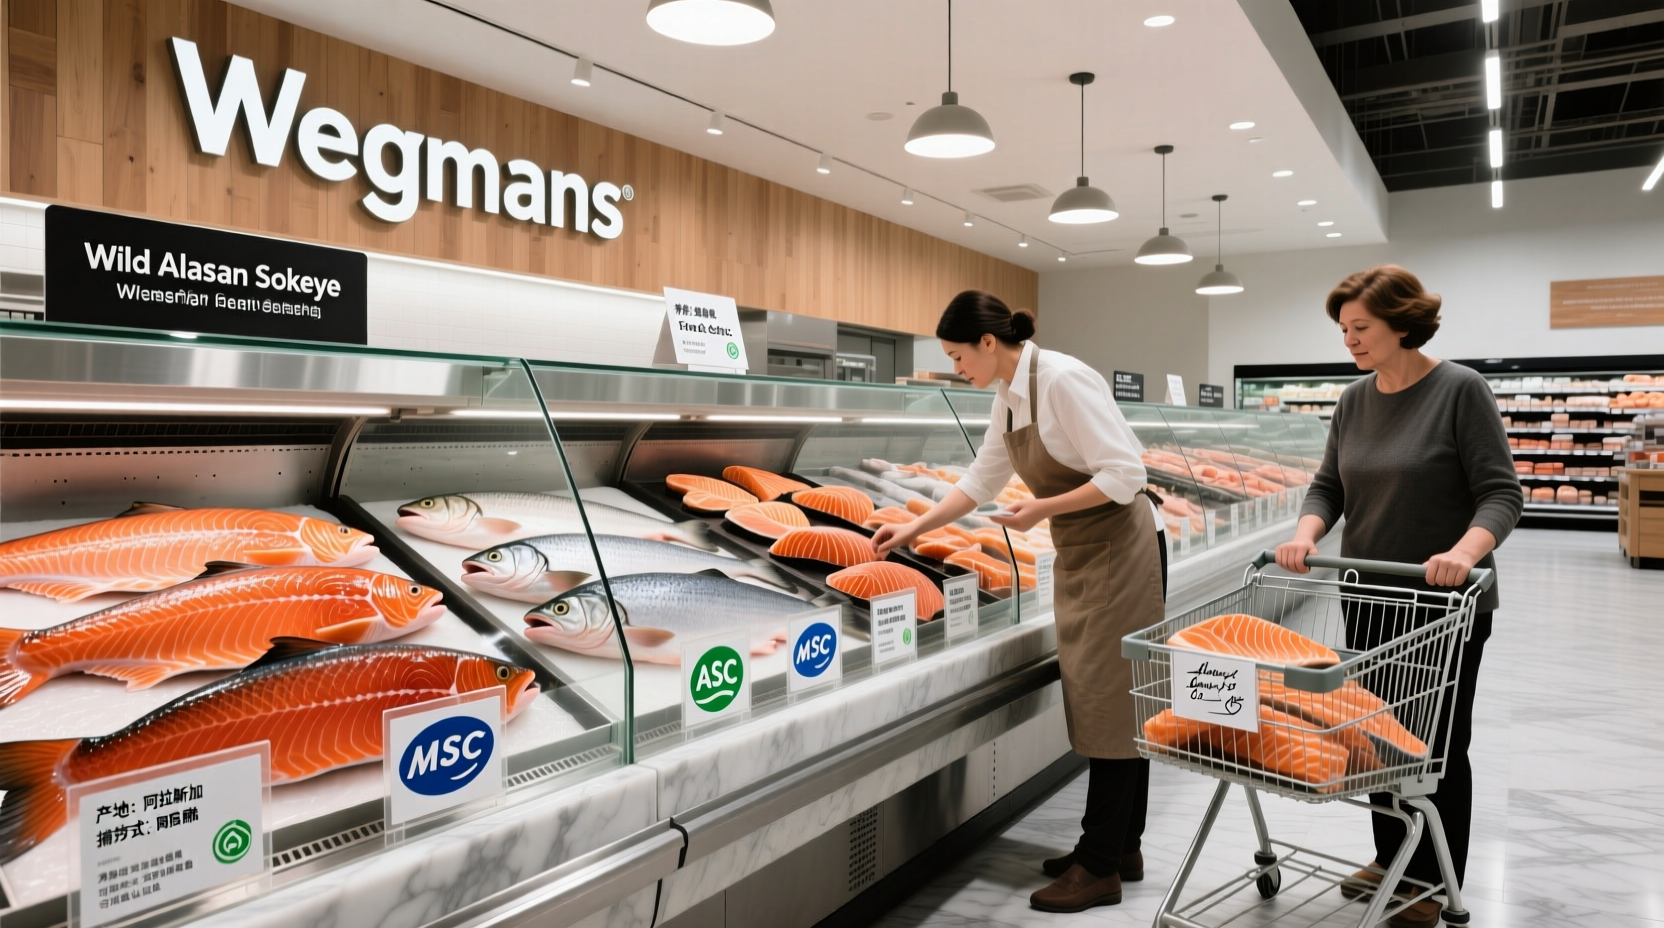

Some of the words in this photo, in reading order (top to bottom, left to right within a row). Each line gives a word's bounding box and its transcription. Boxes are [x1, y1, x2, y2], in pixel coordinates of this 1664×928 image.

[168, 36, 625, 240] Wegmans
[84, 241, 151, 276] Wild
[158, 252, 248, 287] Alasan
[255, 265, 341, 301] Sokeye
[796, 633, 832, 665] MSC
[695, 658, 738, 693] ASC
[407, 730, 486, 780] MSC
